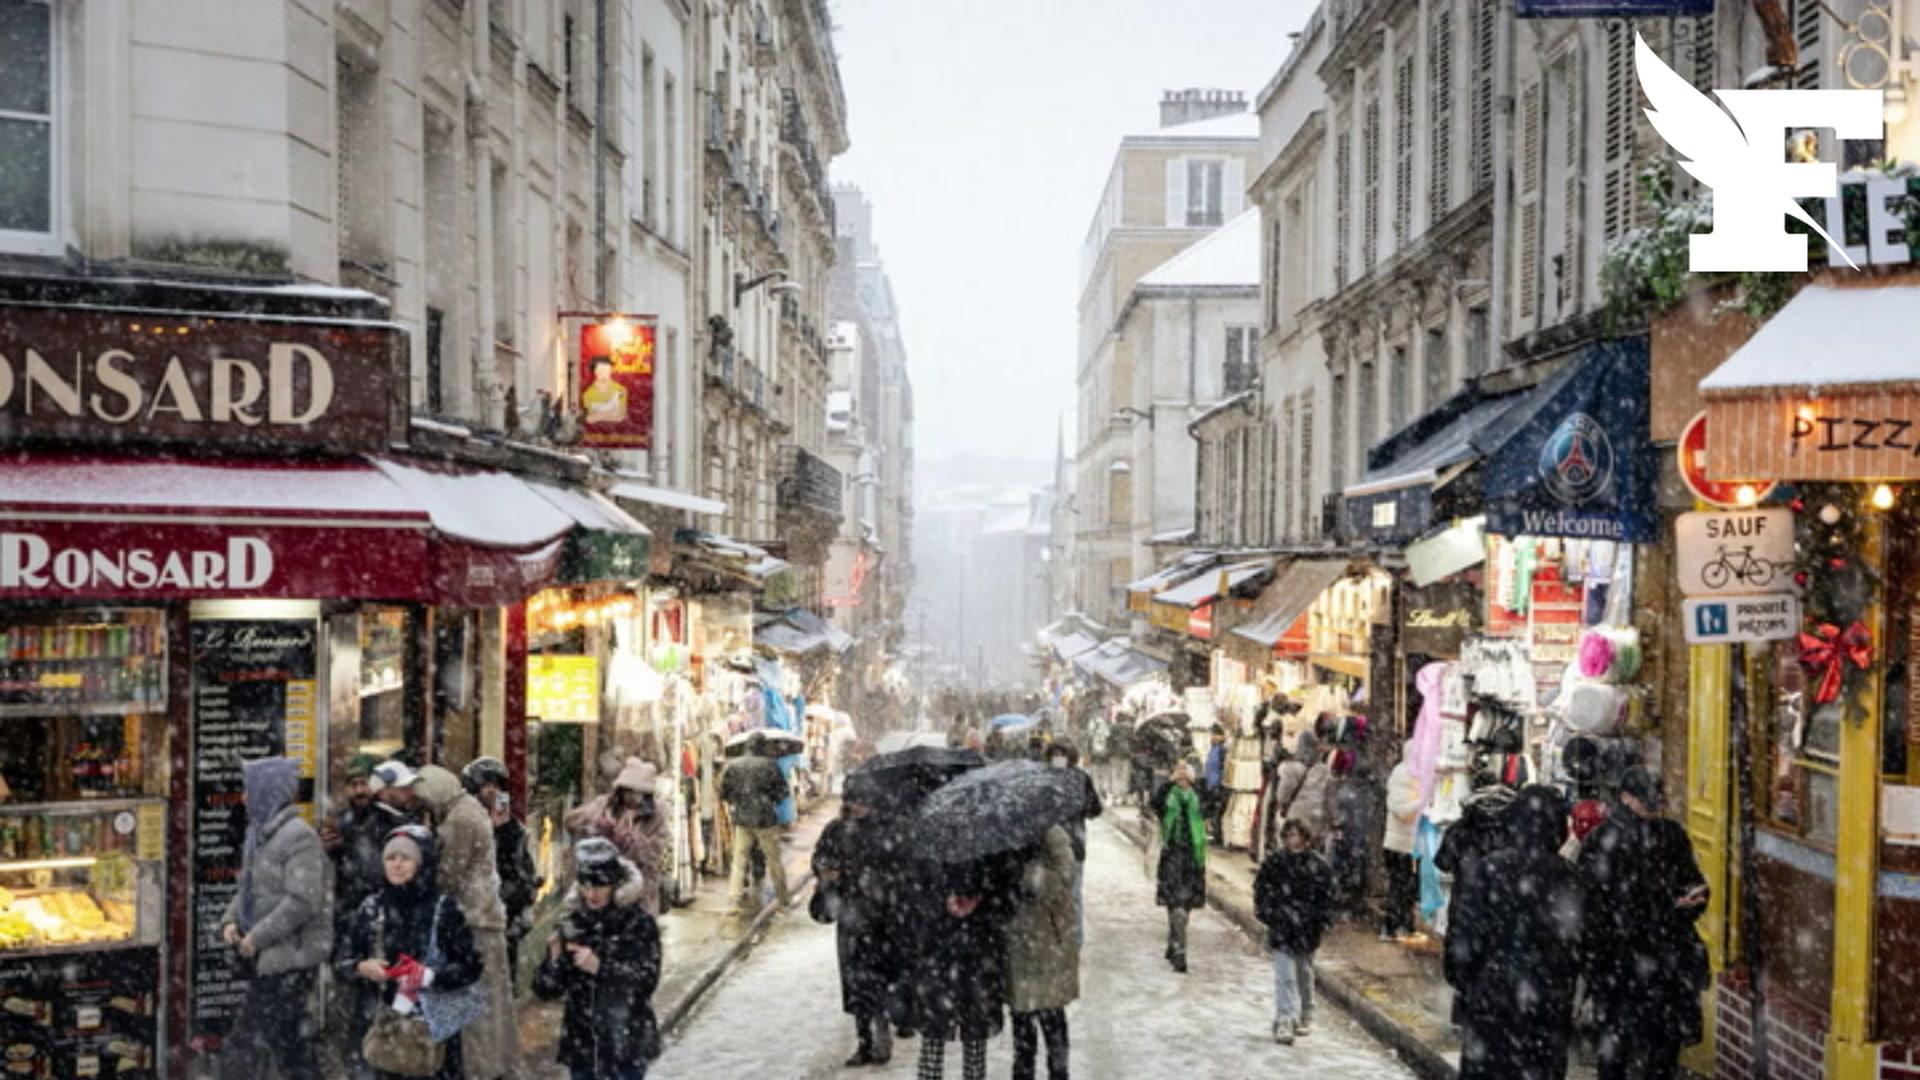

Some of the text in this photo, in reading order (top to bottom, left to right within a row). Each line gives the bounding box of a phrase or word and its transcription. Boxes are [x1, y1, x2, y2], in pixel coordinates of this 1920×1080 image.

[1825, 176, 1911, 268] LE
[1790, 414, 1920, 458] PIZZ
[1522, 509, 1625, 537] Welcome
[1706, 516, 1768, 539] SAUF
[0, 532, 274, 590] RONSARD
